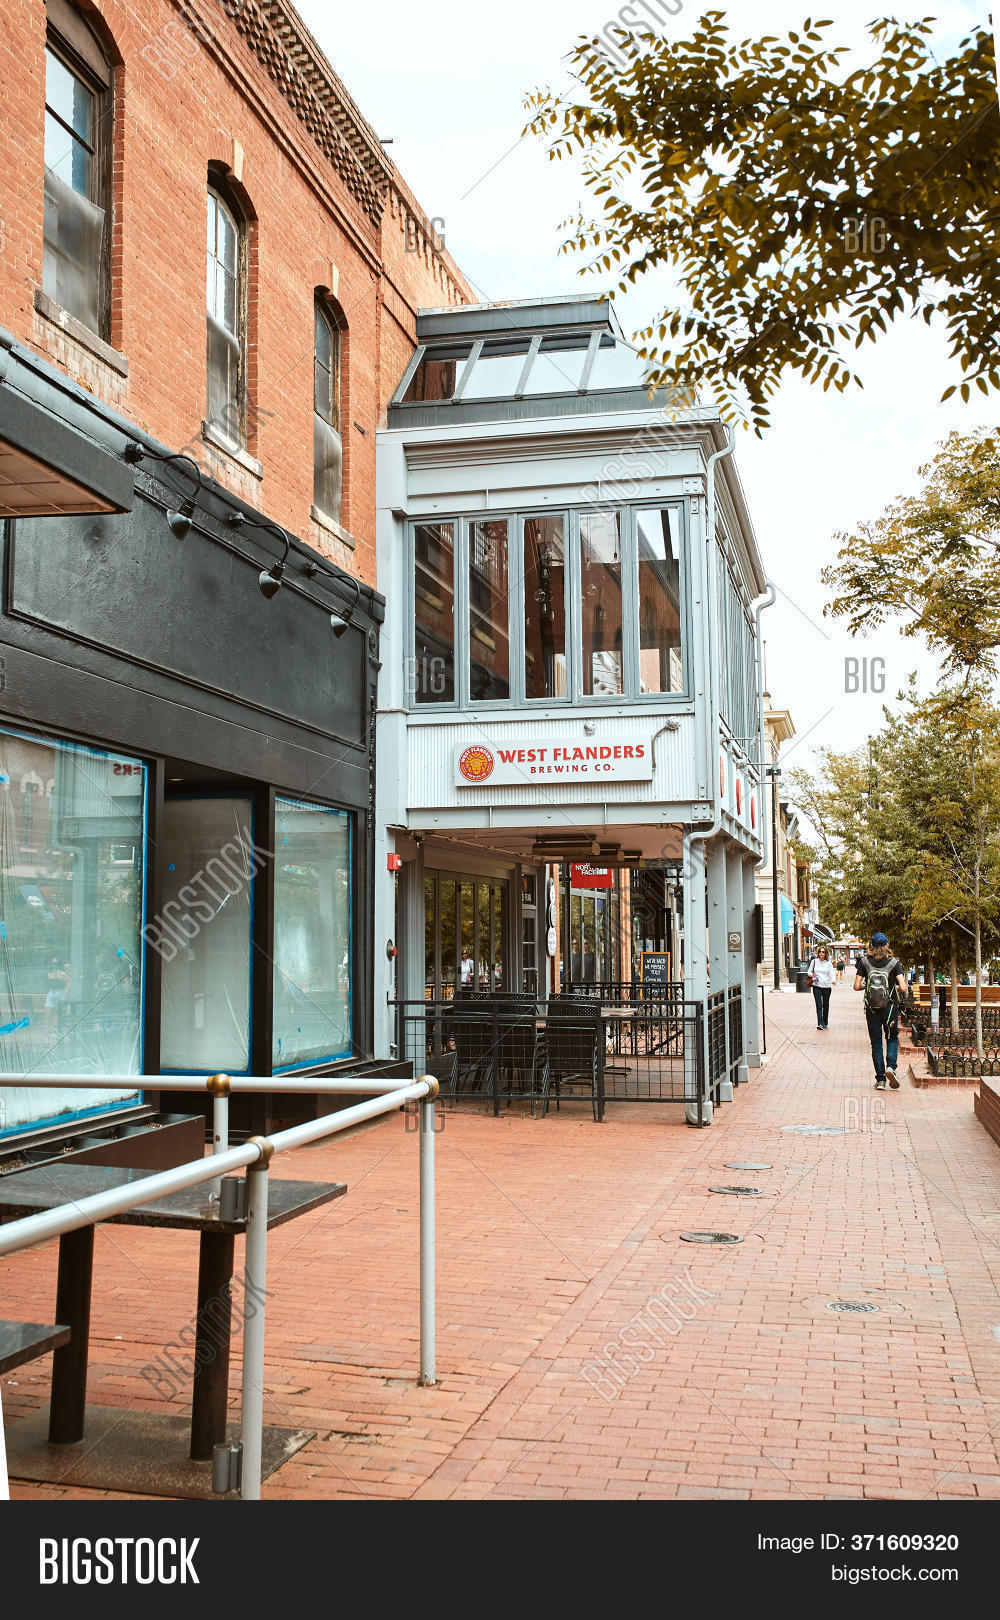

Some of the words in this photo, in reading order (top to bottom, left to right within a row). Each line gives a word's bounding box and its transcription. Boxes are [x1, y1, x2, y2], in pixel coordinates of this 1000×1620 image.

[497, 748, 548, 763] WEST
[553, 745, 645, 761] FLANDERS
[530, 764, 588, 774] BREWING
[595, 763, 615, 772] CO.
